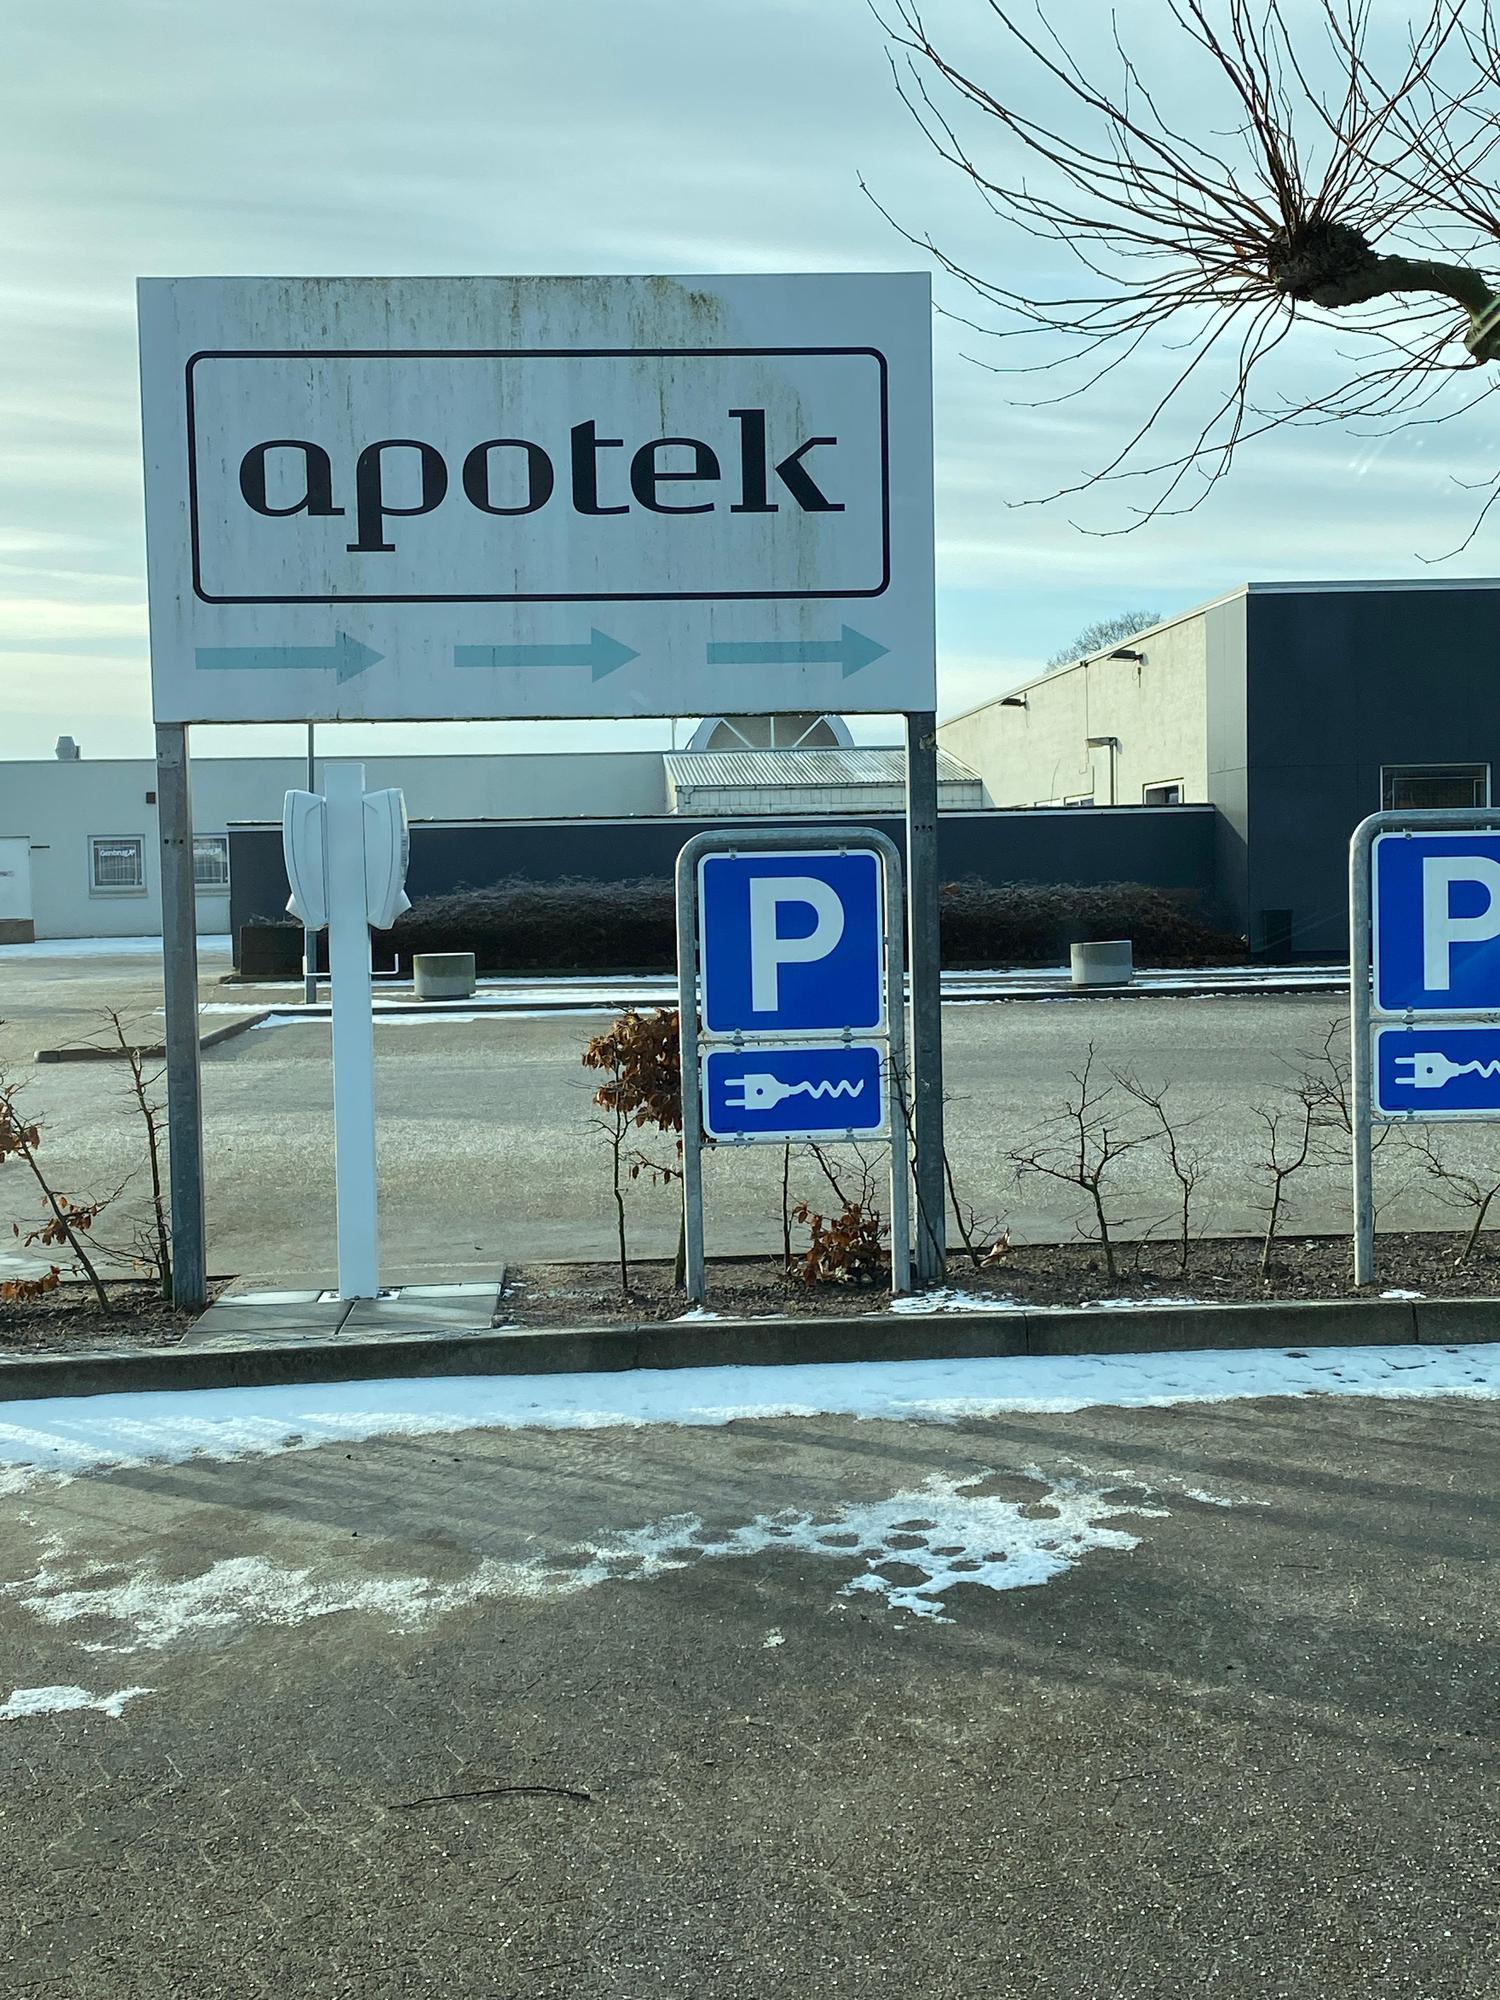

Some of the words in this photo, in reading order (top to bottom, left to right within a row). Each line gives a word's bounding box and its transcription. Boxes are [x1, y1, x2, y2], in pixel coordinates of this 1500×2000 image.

[239, 408, 846, 553] apotek
[749, 876, 845, 1012] P
[1423, 856, 1500, 991] P
